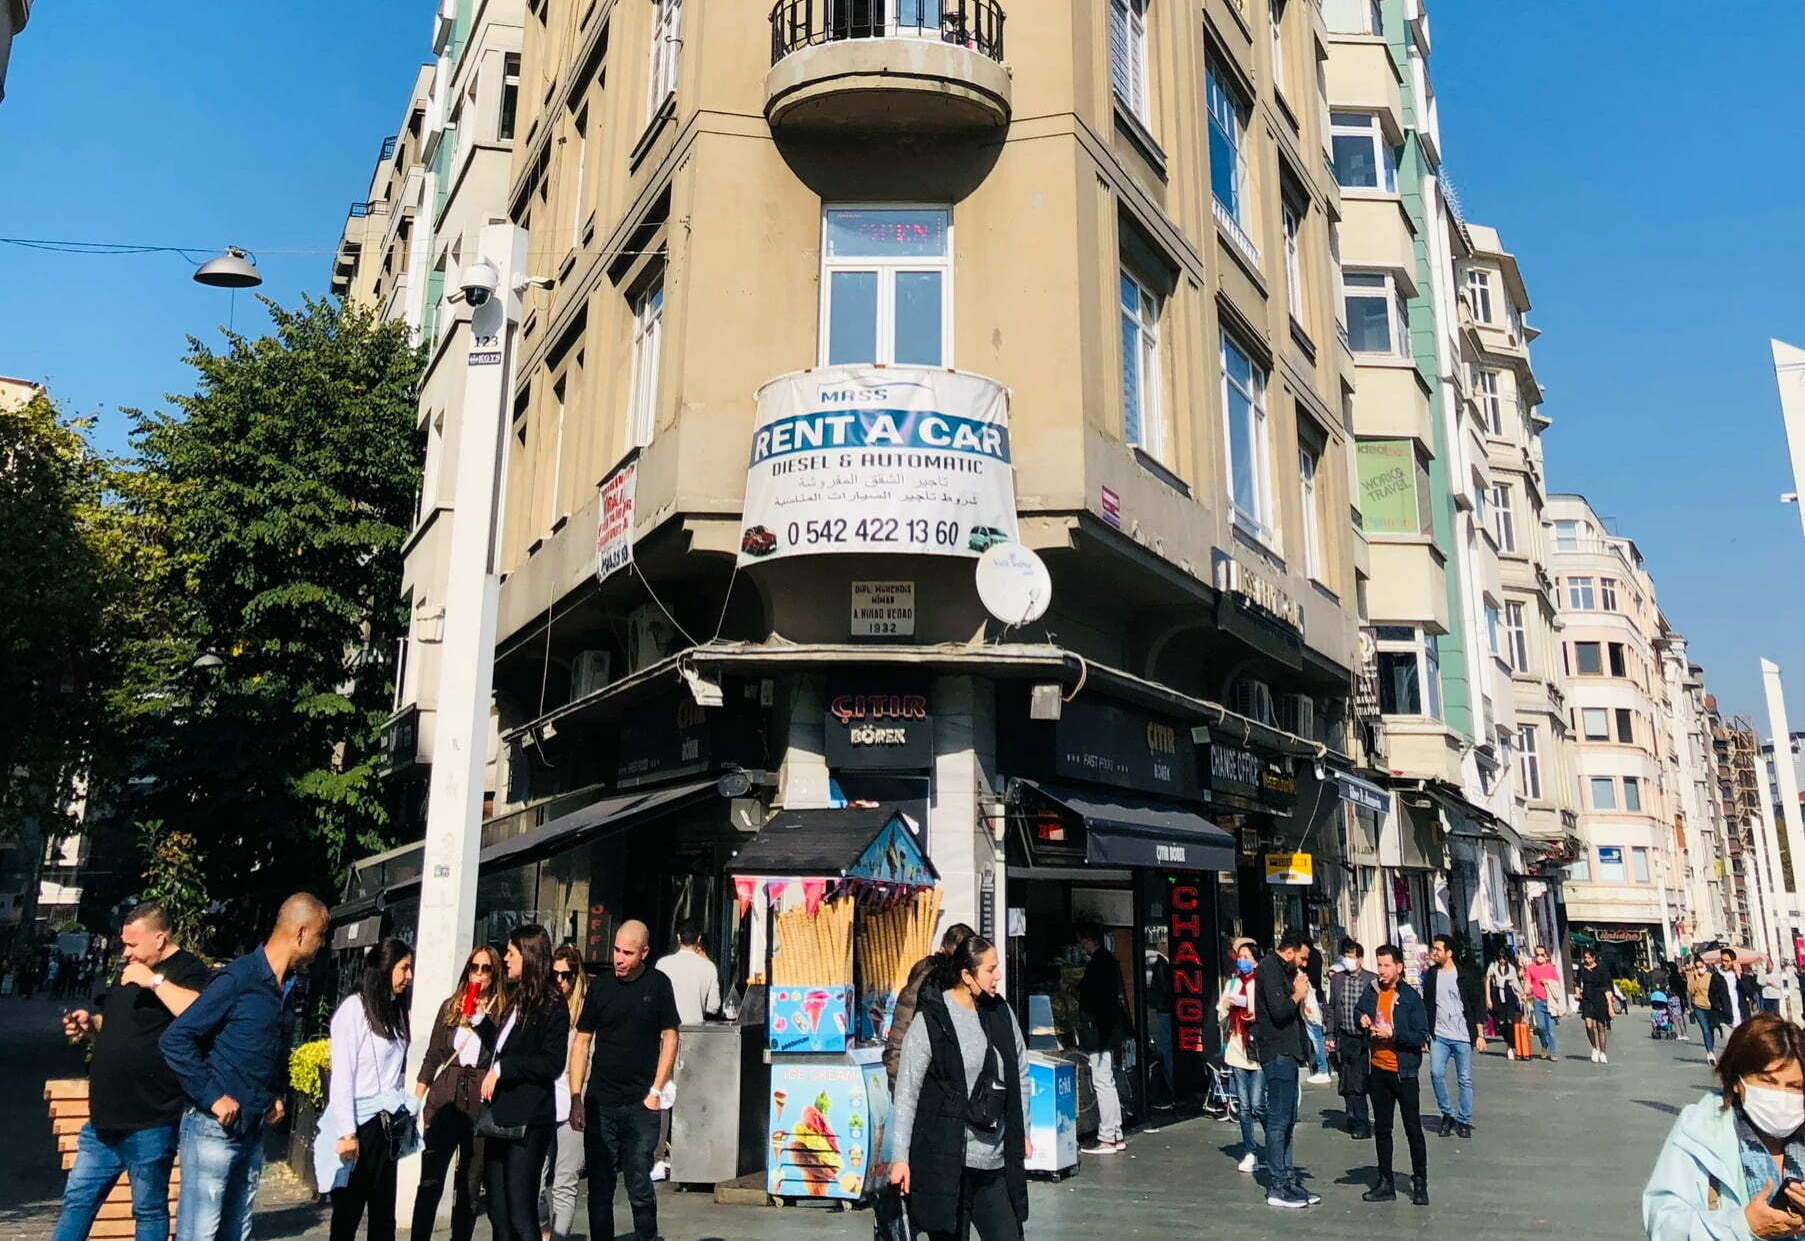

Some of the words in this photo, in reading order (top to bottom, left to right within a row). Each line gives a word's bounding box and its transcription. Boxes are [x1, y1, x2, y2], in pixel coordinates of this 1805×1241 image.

[474, 335, 498, 348] 123
[821, 389, 888, 404] MASS
[754, 415, 855, 462] RENT
[864, 414, 905, 445] A
[918, 416, 1003, 458] CAR
[772, 455, 831, 477] DIESEL
[839, 454, 851, 468] &
[861, 453, 984, 475] AUTOMATIC
[1367, 479, 1411, 502] TRAVEL
[787, 521, 800, 546] 0
[806, 518, 848, 545] 542
[855, 518, 899, 543] 422
[906, 519, 929, 544] 13
[936, 520, 959, 547] 60
[869, 622, 897, 634] 1932
[831, 694, 927, 724] ÇITIR
[850, 724, 906, 745] BÖREK
[1210, 743, 1237, 781] CHANGE
[1170, 885, 1204, 1053] CHANGE
